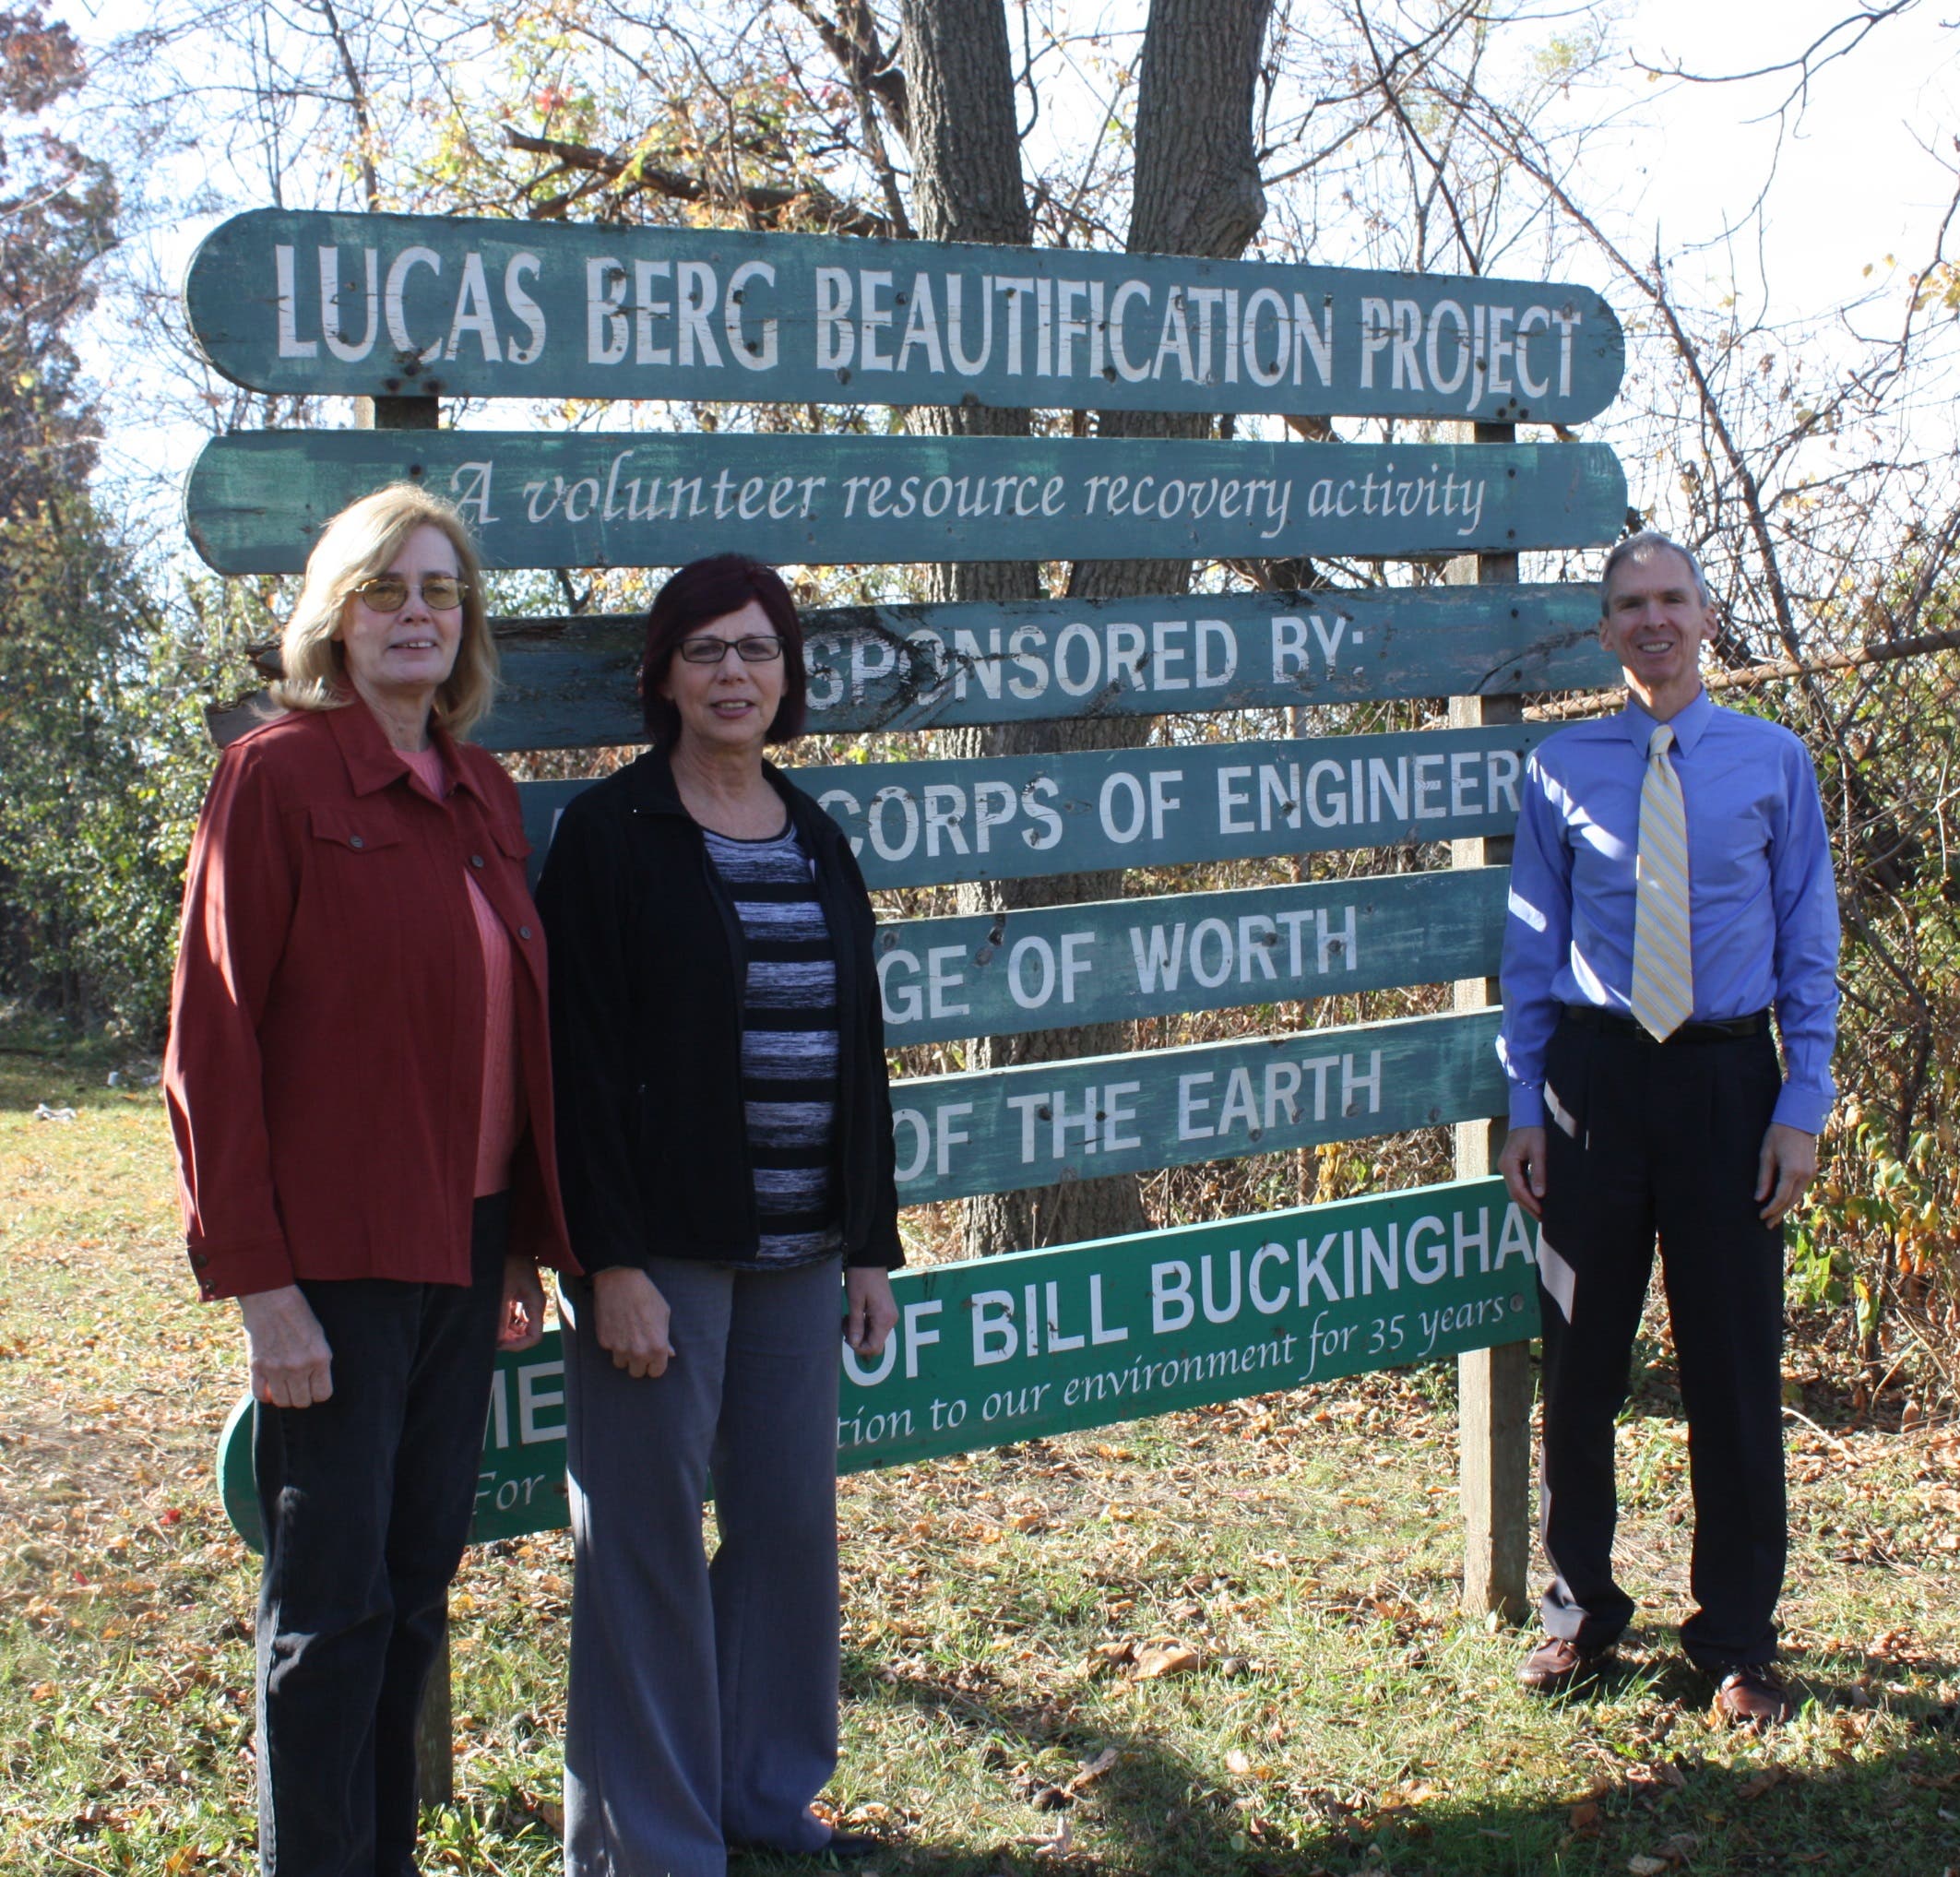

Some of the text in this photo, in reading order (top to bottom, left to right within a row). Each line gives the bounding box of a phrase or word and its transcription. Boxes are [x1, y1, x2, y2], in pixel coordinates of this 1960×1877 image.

[277, 244, 1582, 412] LUCAS BERG BEAUTIFICATION PROJECT
[450, 449, 1485, 539] A volunteer resource recovery activity
[805, 619, 1238, 710] SPONSORED
[821, 750, 1521, 861] CORPS OF ENGINEER
[1007, 932, 1096, 1010] OF
[1129, 905, 1358, 994] WORTH
[892, 1050, 1382, 1182] OF THE EARTH
[841, 1300, 943, 1387] OF
[971, 1274, 1129, 1366] BILL
[1151, 1202, 1536, 1335] BUCKINGHA
[471, 1471, 546, 1515] For
[929, 1397, 968, 1432] to
[981, 1382, 1051, 1422] our
[1063, 1346, 1295, 1407] environment
[1298, 1311, 1358, 1383] for
[1368, 1315, 1405, 1352] 35
[1417, 1296, 1504, 1358] years
